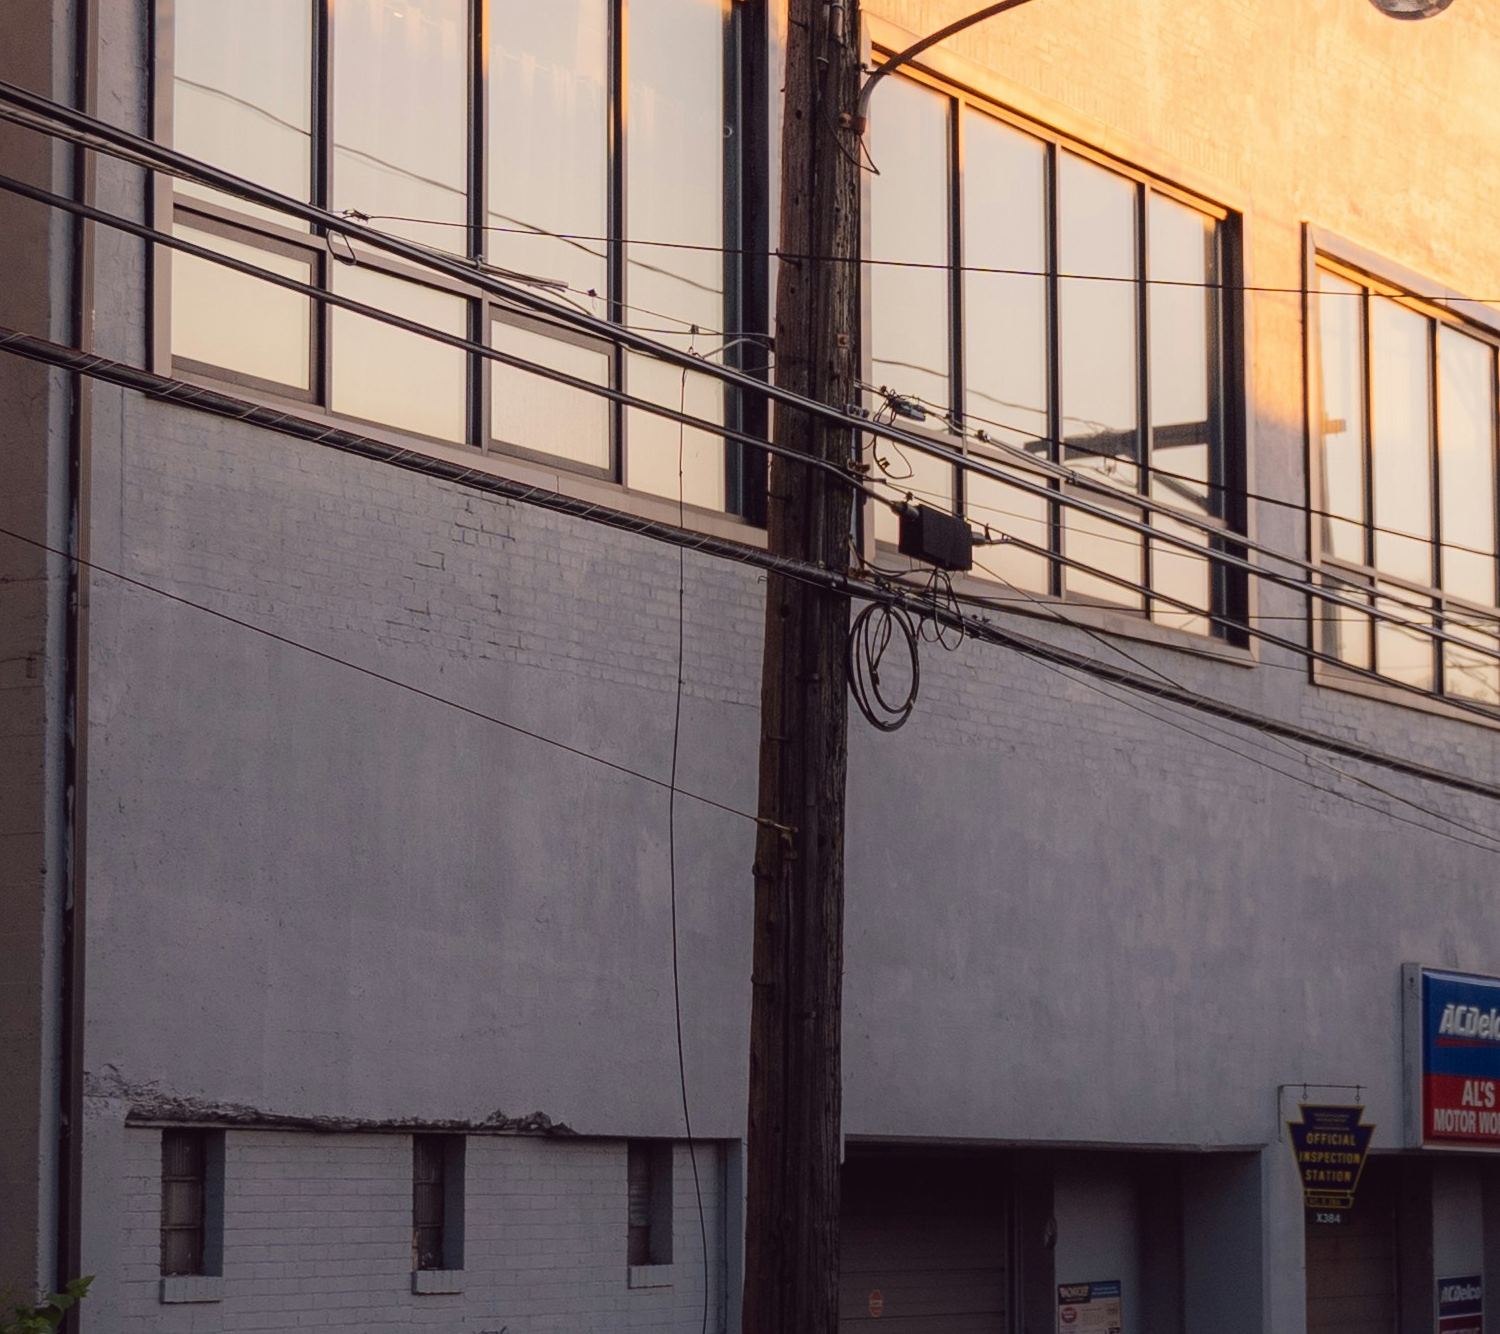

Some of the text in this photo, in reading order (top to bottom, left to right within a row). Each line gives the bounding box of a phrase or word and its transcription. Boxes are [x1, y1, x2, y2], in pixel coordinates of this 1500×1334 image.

[1461, 1080, 1495, 1108] AL'S
[1433, 1108, 1477, 1134] MOTOR
[1306, 1132, 1356, 1146] OFFICIAL
[1299, 1151, 1361, 1165] INSPECTION
[1305, 1169, 1352, 1182] STATION
